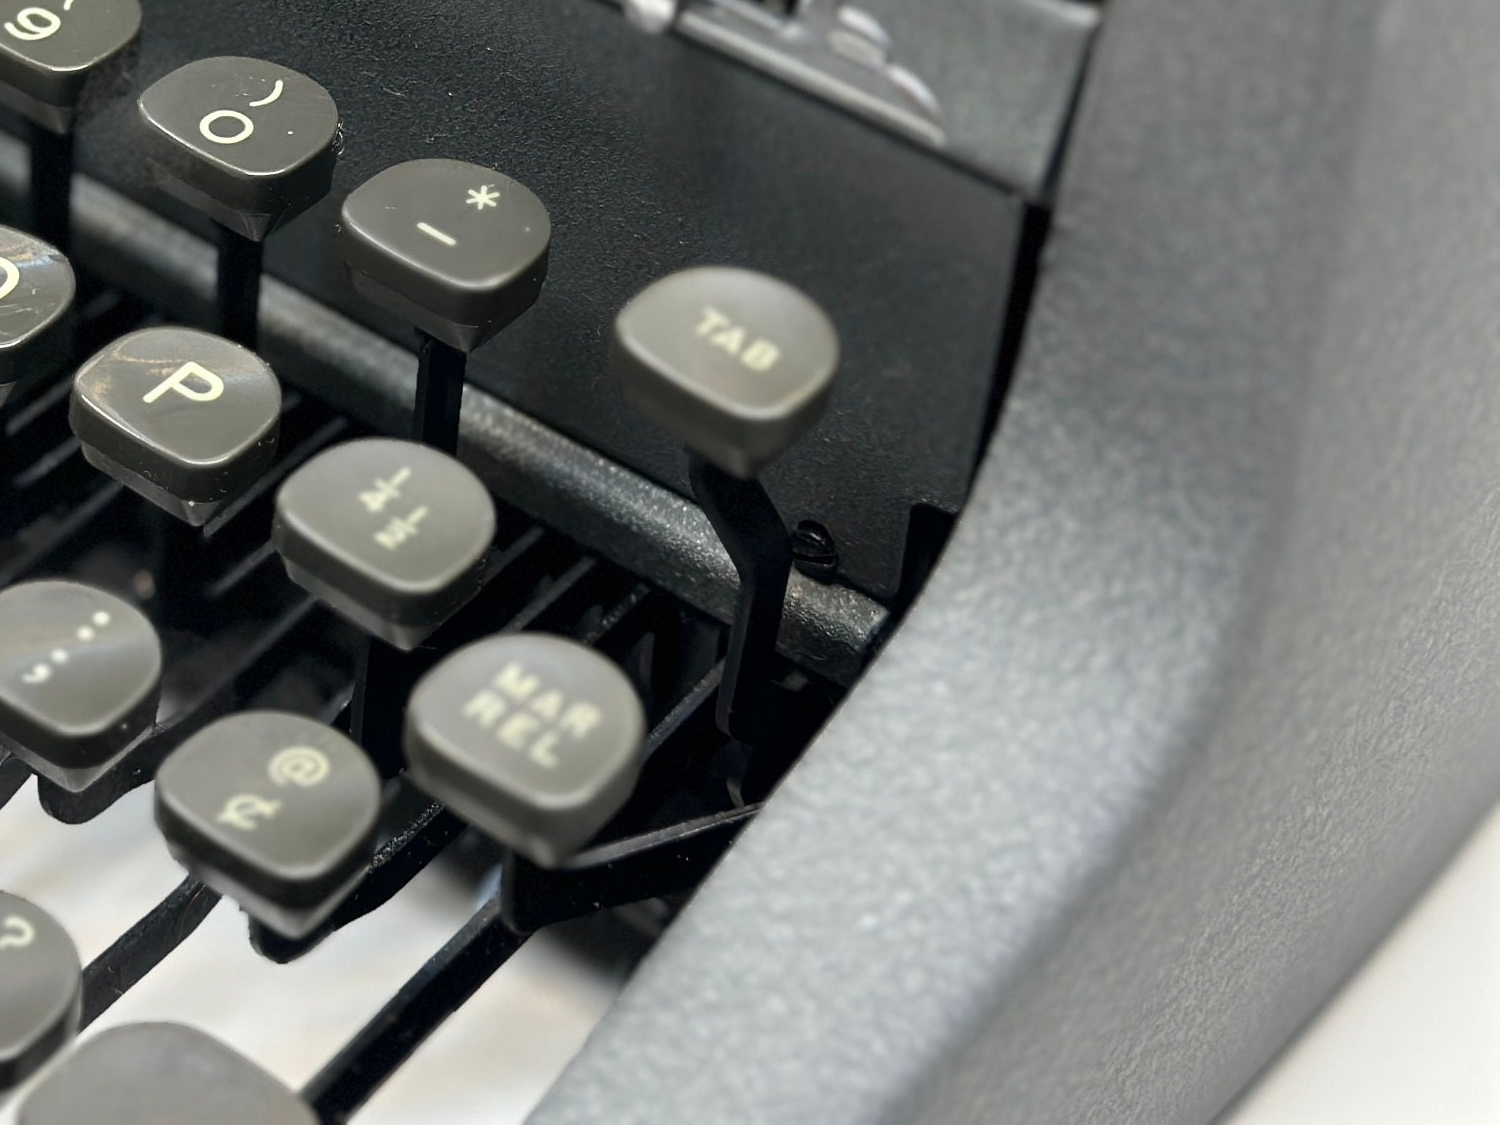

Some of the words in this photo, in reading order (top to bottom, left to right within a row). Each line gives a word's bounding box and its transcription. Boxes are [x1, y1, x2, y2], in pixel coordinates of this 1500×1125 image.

[3, 5, 62, 42] 9
[696, 306, 780, 374] TAB
[142, 361, 225, 404] P
[495, 659, 602, 741] MAR
[461, 689, 561, 769] REL
[267, 744, 331, 789] @
